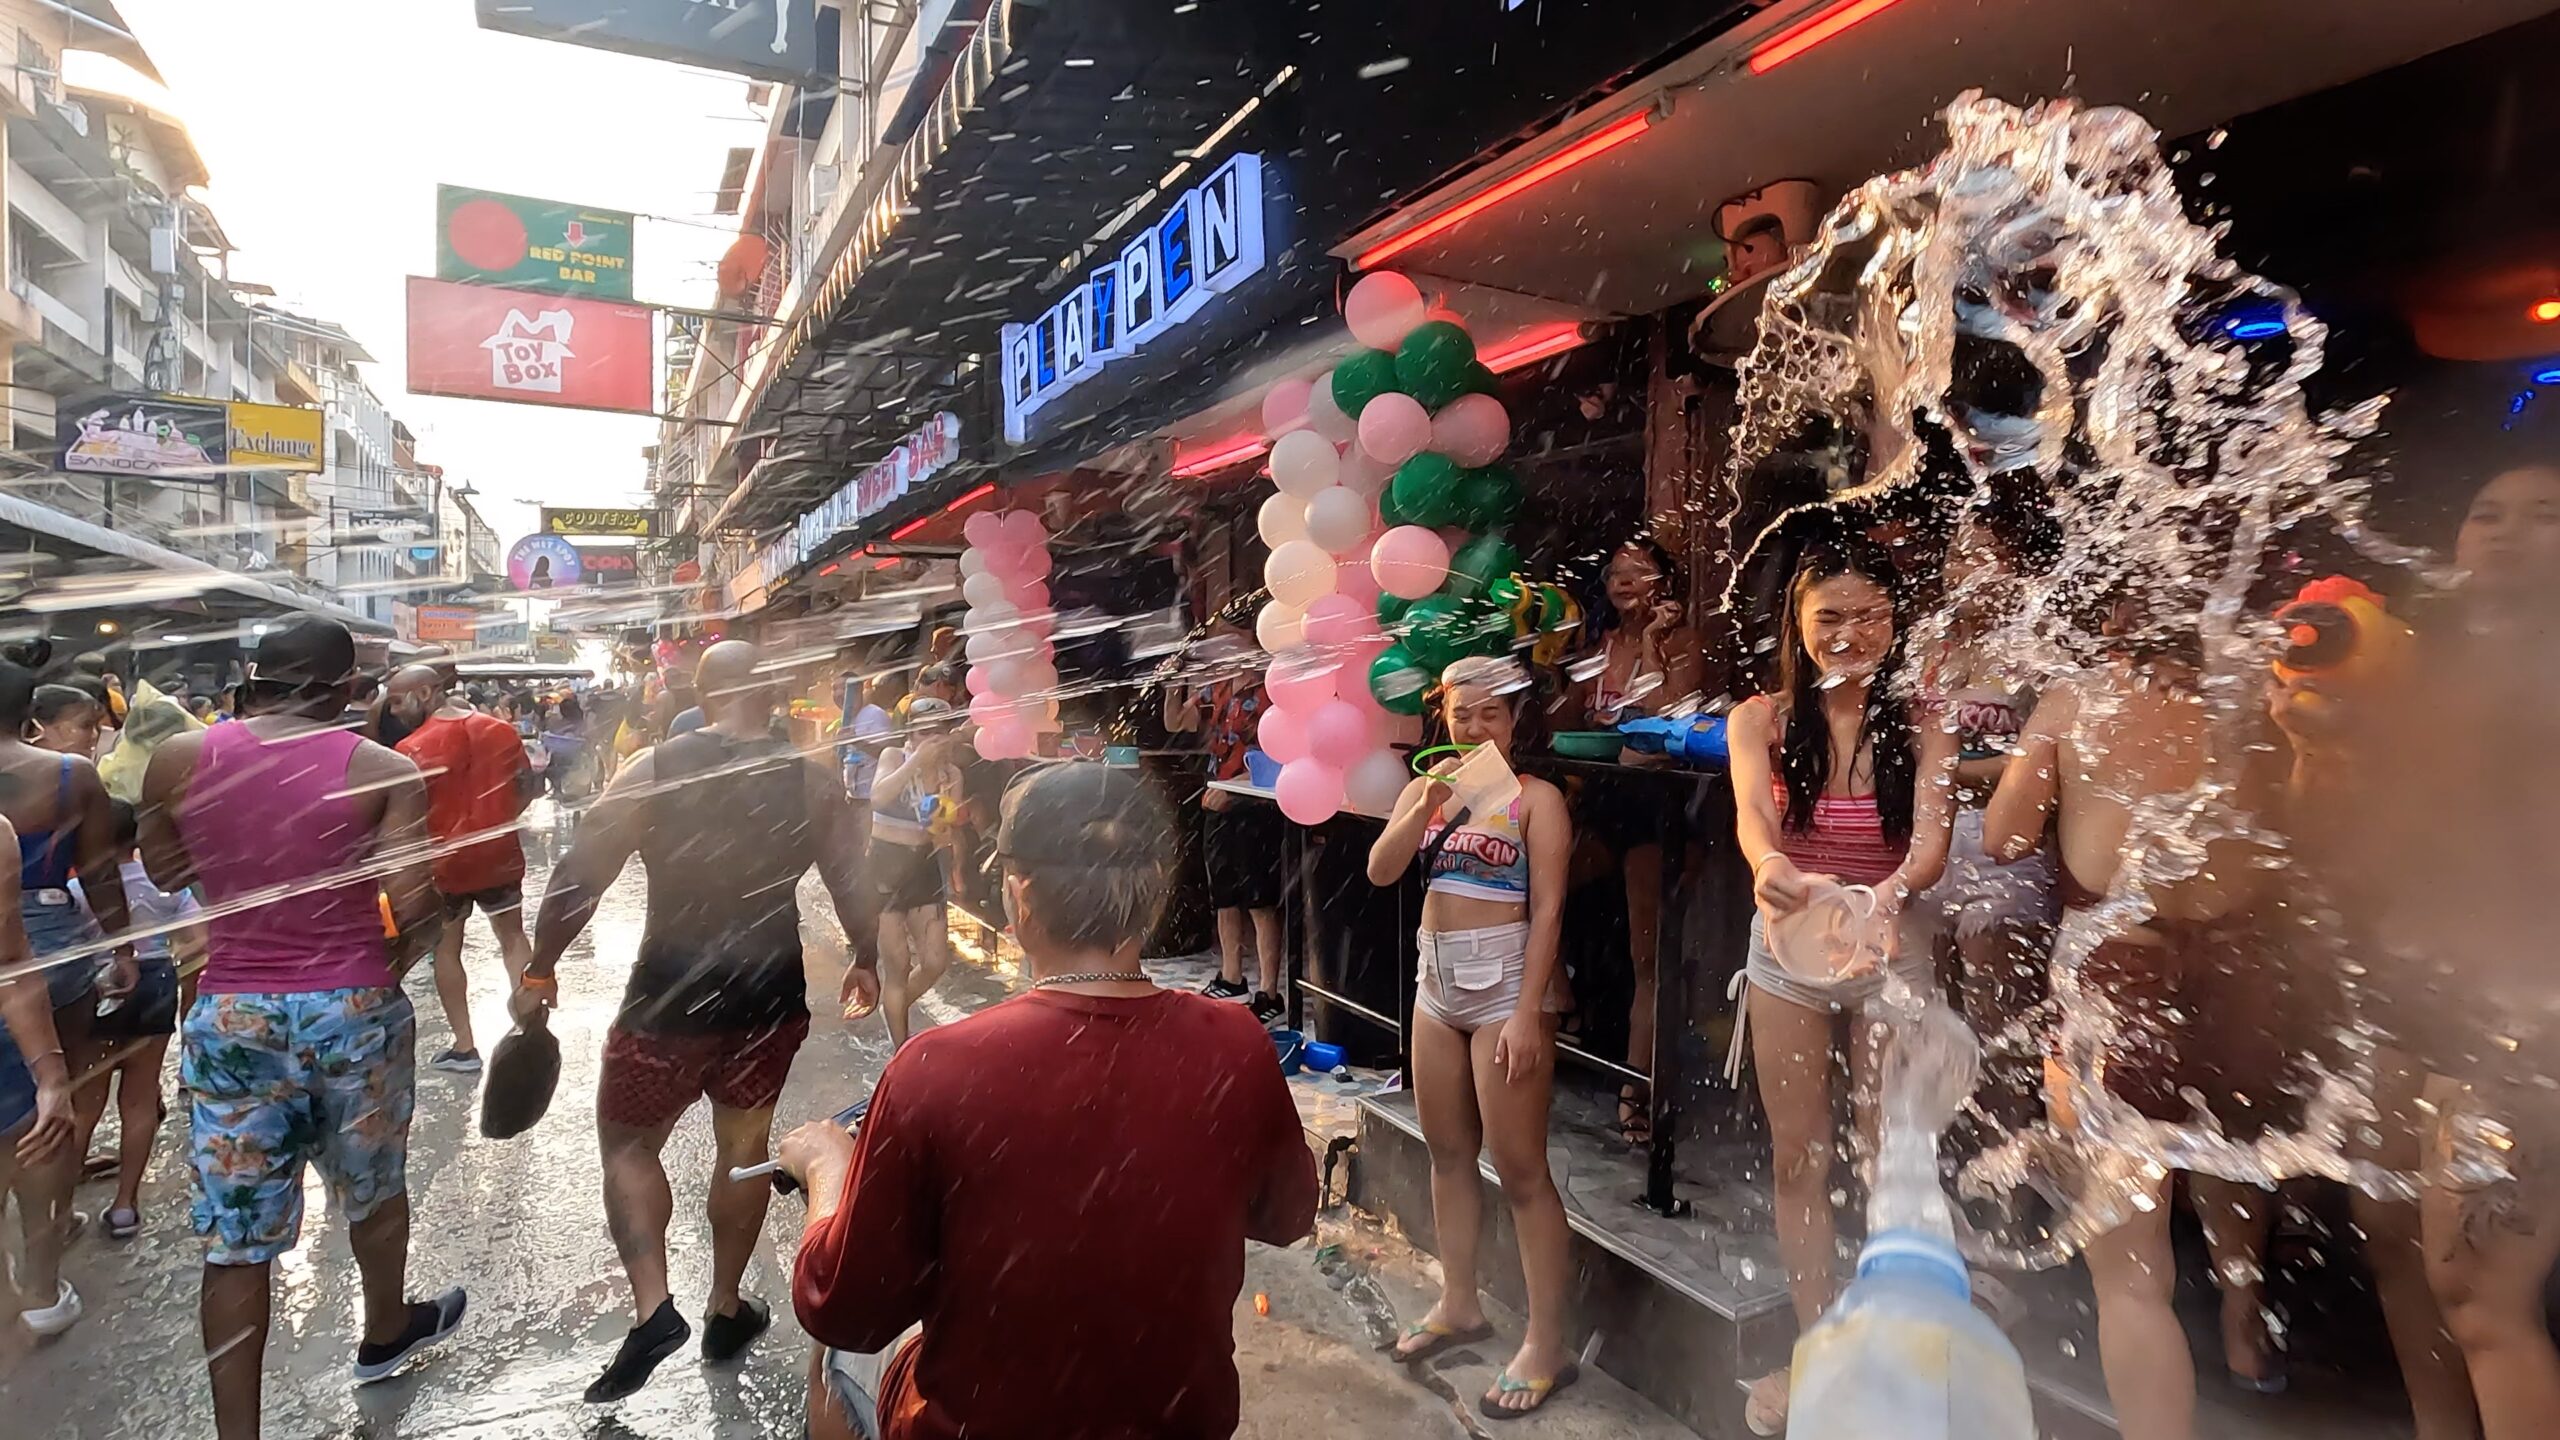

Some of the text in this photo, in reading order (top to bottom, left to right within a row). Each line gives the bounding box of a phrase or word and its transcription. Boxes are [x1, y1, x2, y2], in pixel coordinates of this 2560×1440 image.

[529, 246, 625, 269] RED POINT
[559, 266, 597, 284] BAR
[1013, 168, 1241, 402] PLAYPEN
[229, 427, 315, 459] Exchange
[856, 410, 945, 514] SWEET BAR
[563, 511, 641, 527] COOTERS
[530, 539, 554, 550] WET
